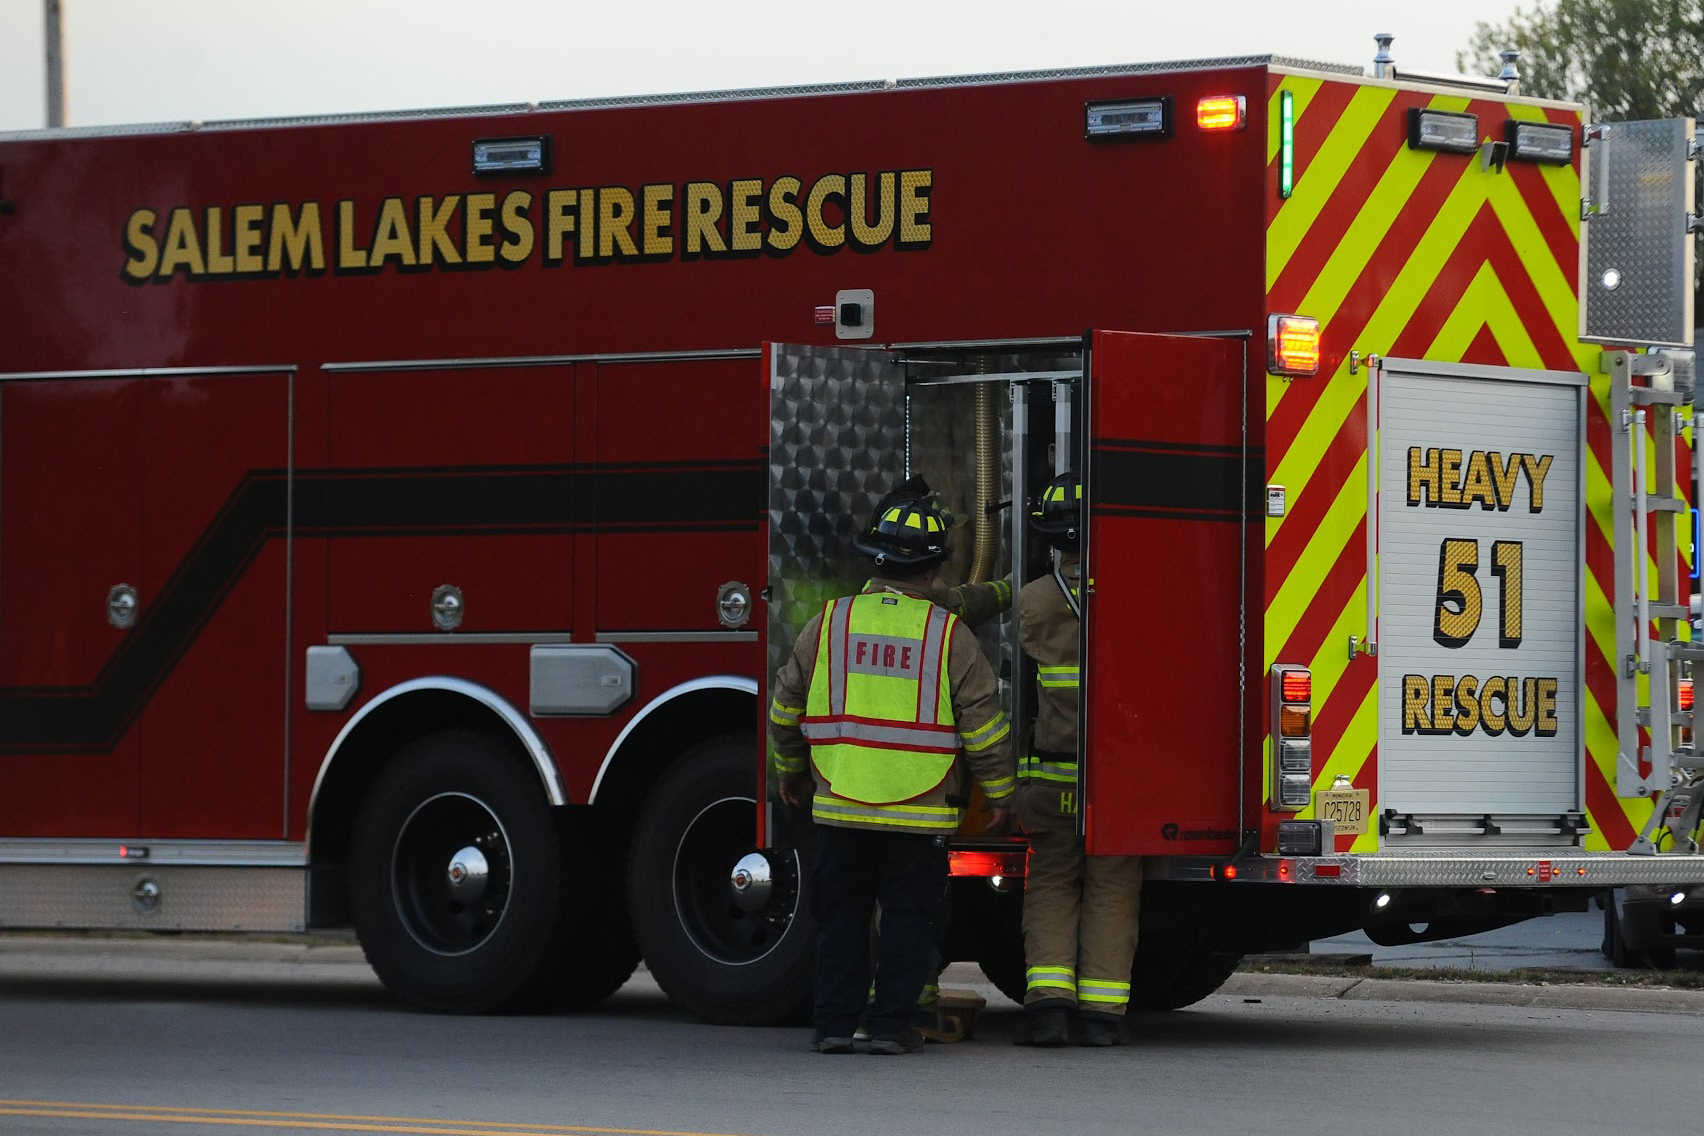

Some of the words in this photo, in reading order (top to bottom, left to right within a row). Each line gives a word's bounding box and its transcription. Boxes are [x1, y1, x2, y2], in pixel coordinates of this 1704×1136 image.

[121, 201, 328, 285] SALEM
[334, 189, 535, 276] LAKES
[542, 182, 675, 267] FIRE
[681, 168, 932, 261] RESCUE
[1407, 446, 1554, 514] HEAVY
[1433, 538, 1523, 649] 51
[856, 642, 911, 669] FIRE
[1402, 674, 1558, 737] RESCUE
